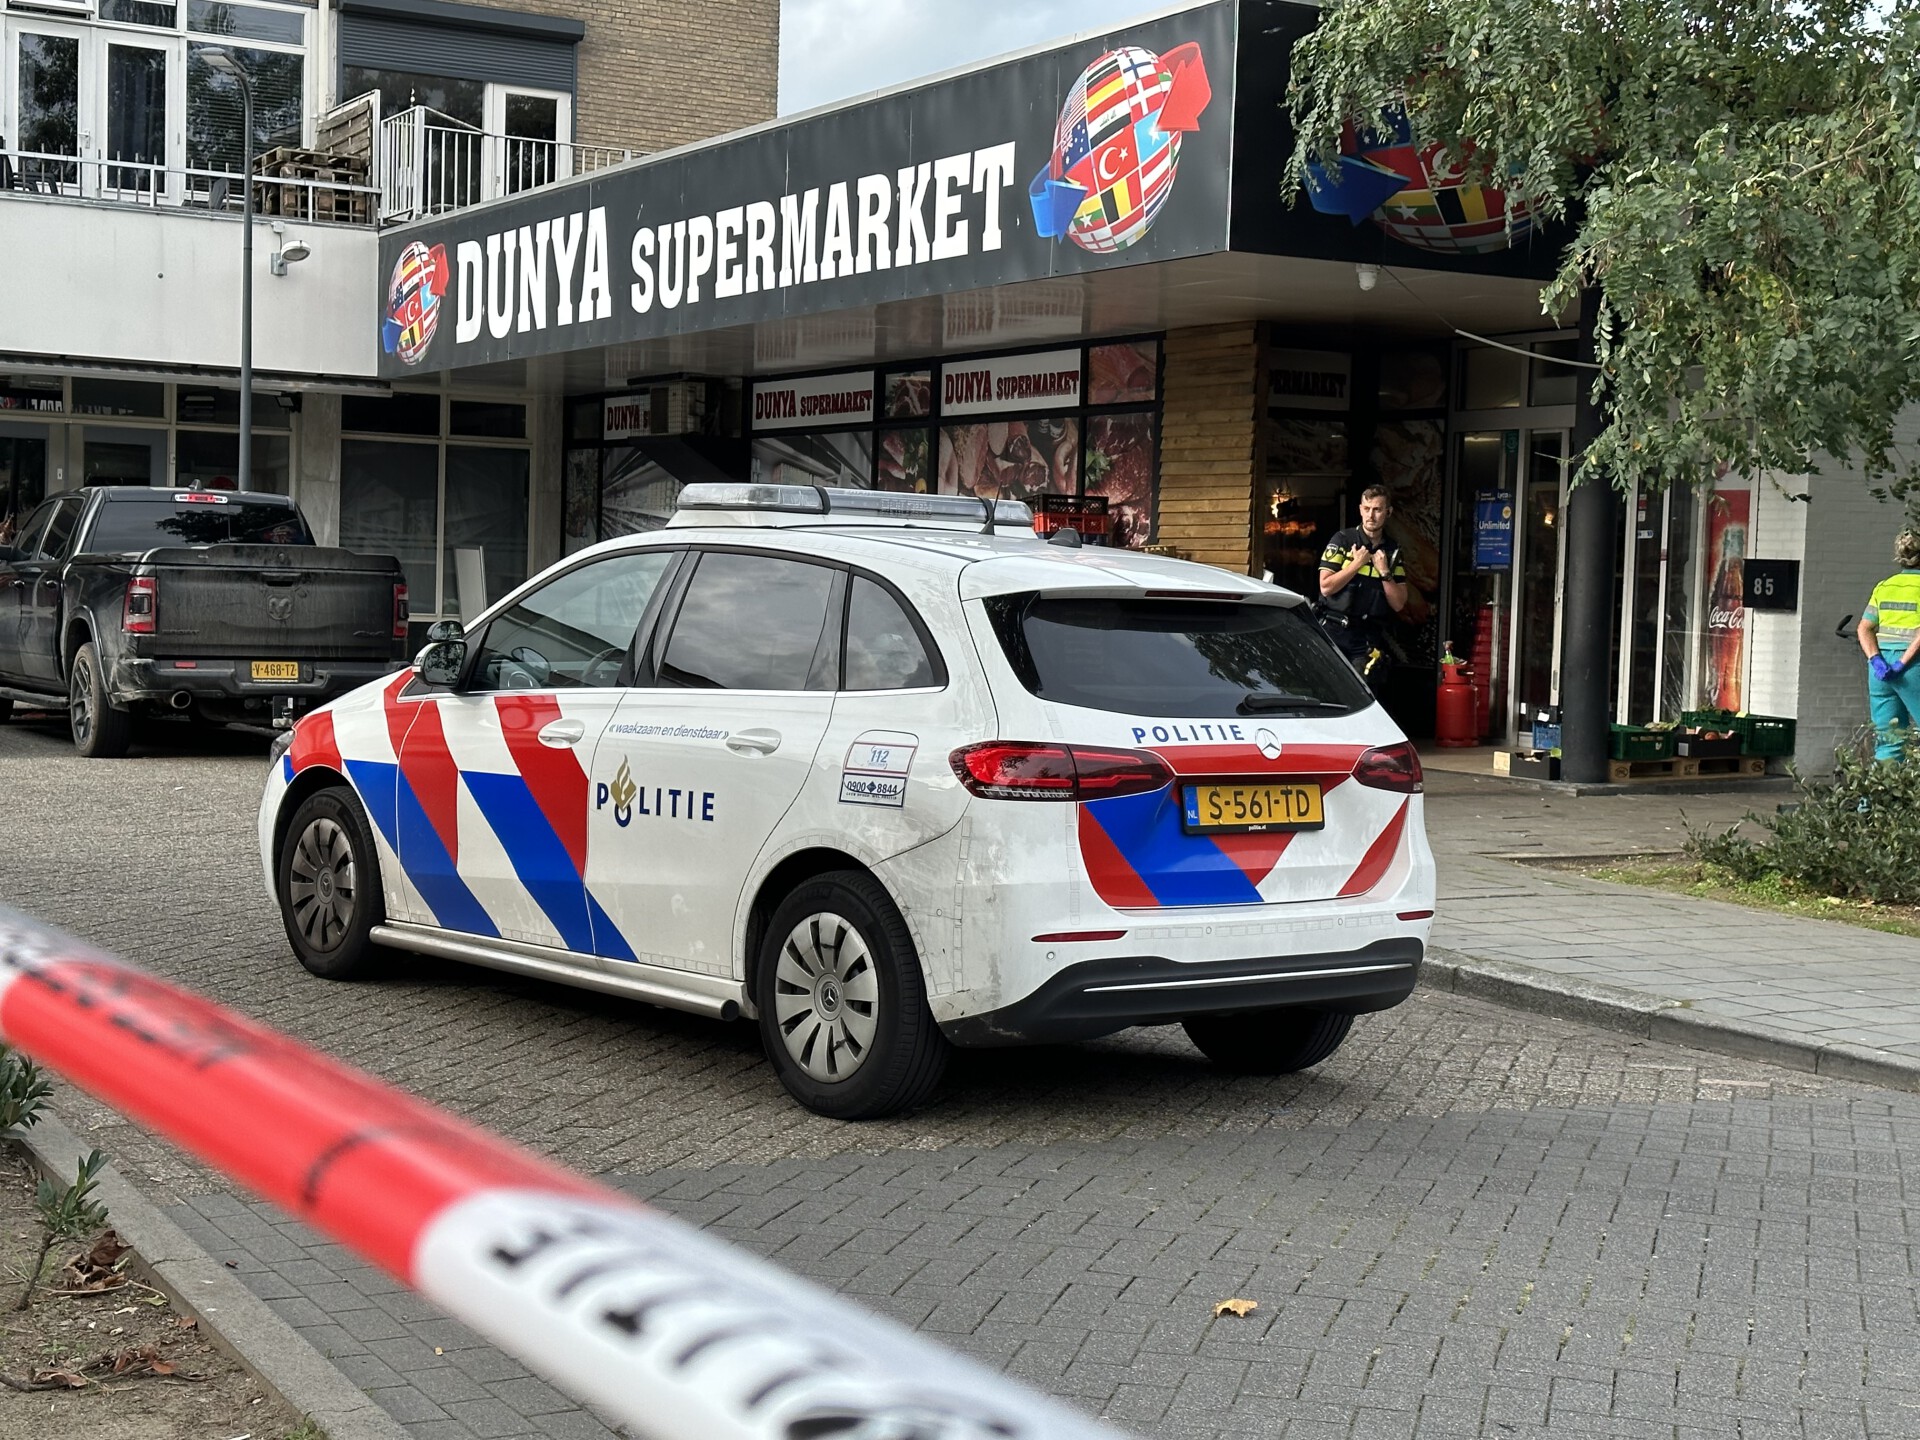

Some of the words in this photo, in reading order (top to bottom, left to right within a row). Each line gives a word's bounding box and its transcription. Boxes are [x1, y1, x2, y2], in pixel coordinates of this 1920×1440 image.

[456, 206, 611, 344] DUNYA
[631, 141, 1016, 314] SUPERMARKET
[946, 370, 992, 404] DUNYA
[997, 370, 1079, 400] SUPERMARKET
[756, 390, 796, 419] DUNYA
[800, 390, 872, 416] SUPERMARKET
[607, 405, 640, 431] DUNYA
[1479, 520, 1510, 530] Unlimited
[1754, 578, 1774, 595] 85
[255, 663, 296, 677] V-468-TZ
[661, 726, 673, 736] en
[1131, 724, 1245, 744] POLITIE
[870, 750, 890, 762] 112
[597, 782, 715, 828] POLITIE
[1187, 810, 1198, 819] NL
[1208, 789, 1310, 820] S-561-TD
